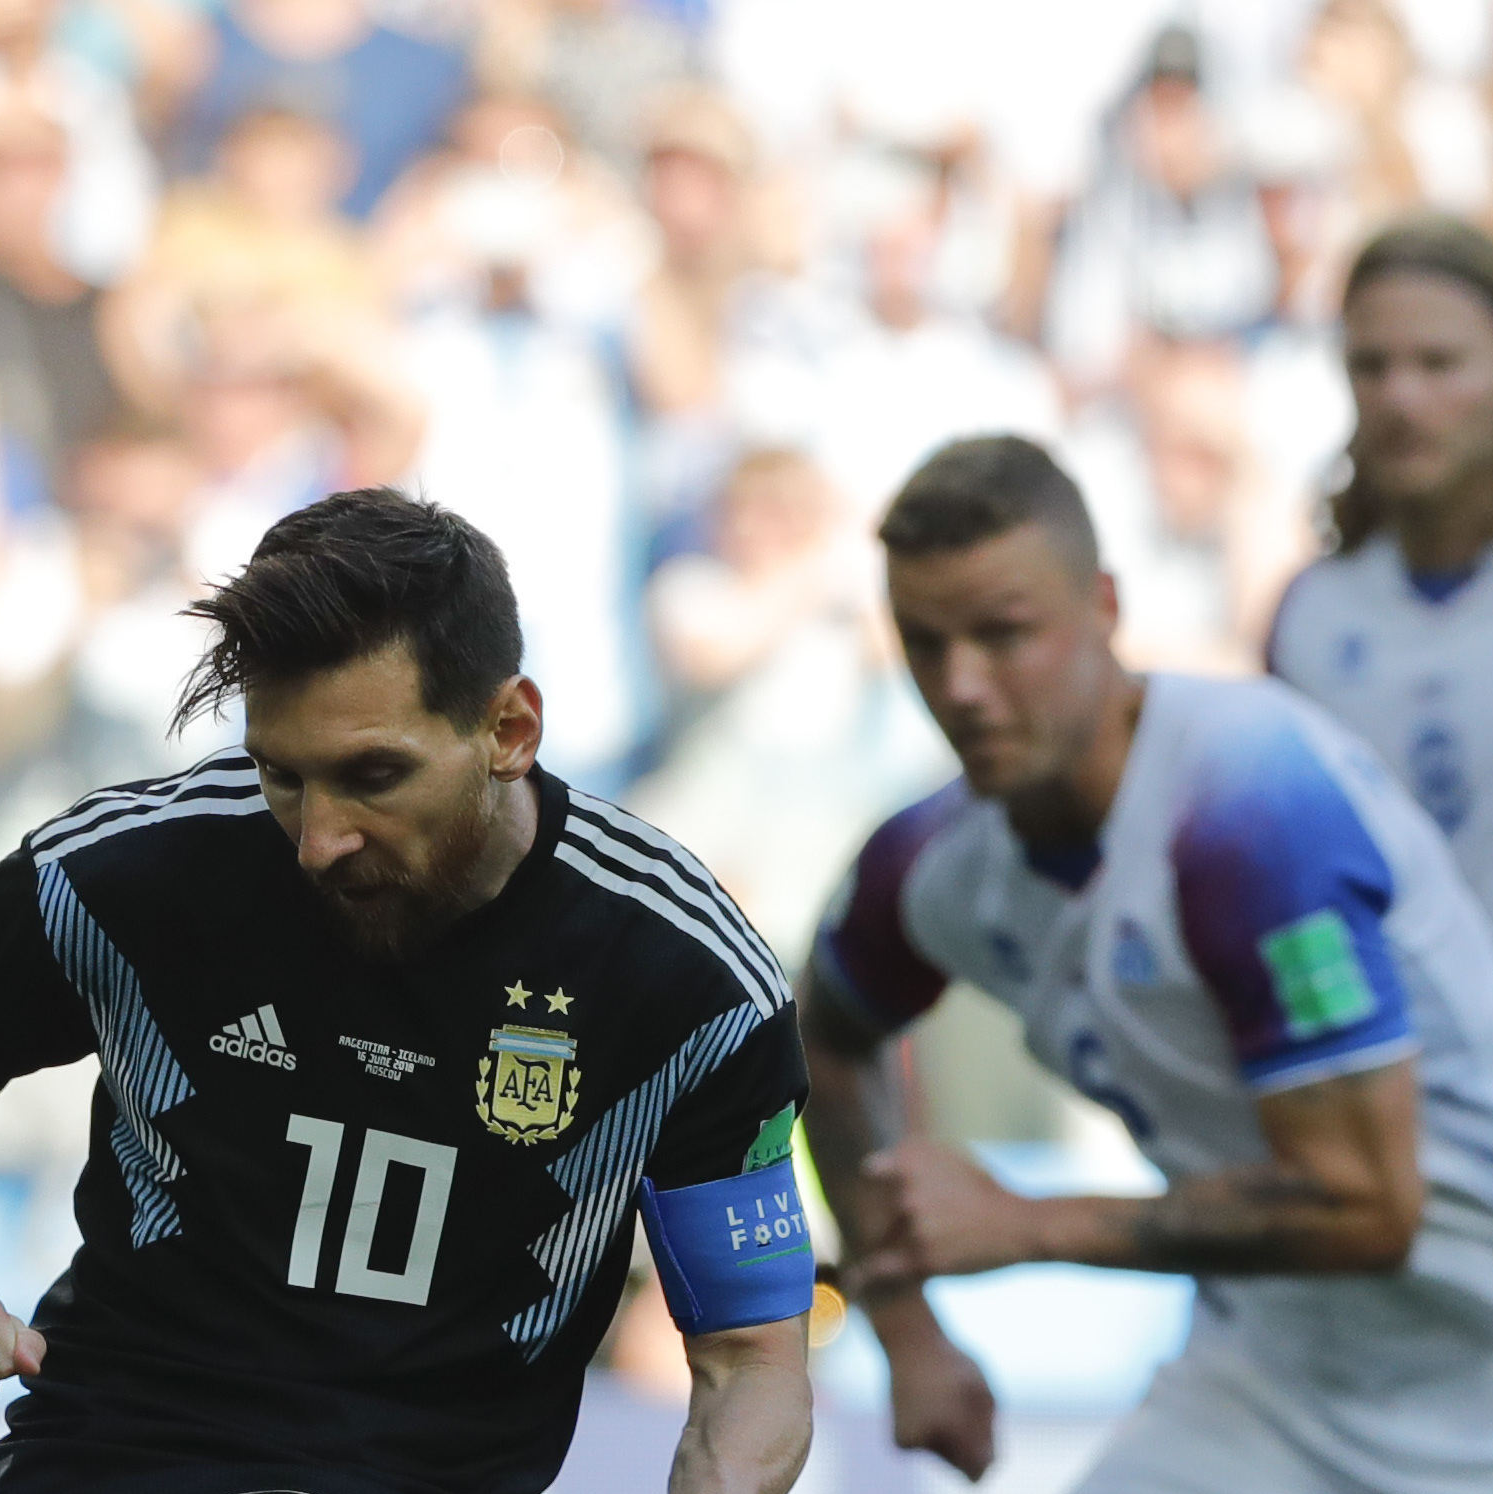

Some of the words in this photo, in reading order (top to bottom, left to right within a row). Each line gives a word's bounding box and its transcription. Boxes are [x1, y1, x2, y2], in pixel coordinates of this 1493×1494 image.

[209, 1035, 297, 1071] adidas
[338, 1035, 390, 1056] ARGENTINA
[397, 1048, 436, 1067] ICELAND
[357, 1050, 366, 1061] 16
[368, 1053, 392, 1067] JUNE
[393, 1059, 415, 1073] 2018
[365, 1063, 402, 1081] MOSCOW
[499, 1055, 554, 1112] AFA
[286, 1113, 458, 1306] 10
